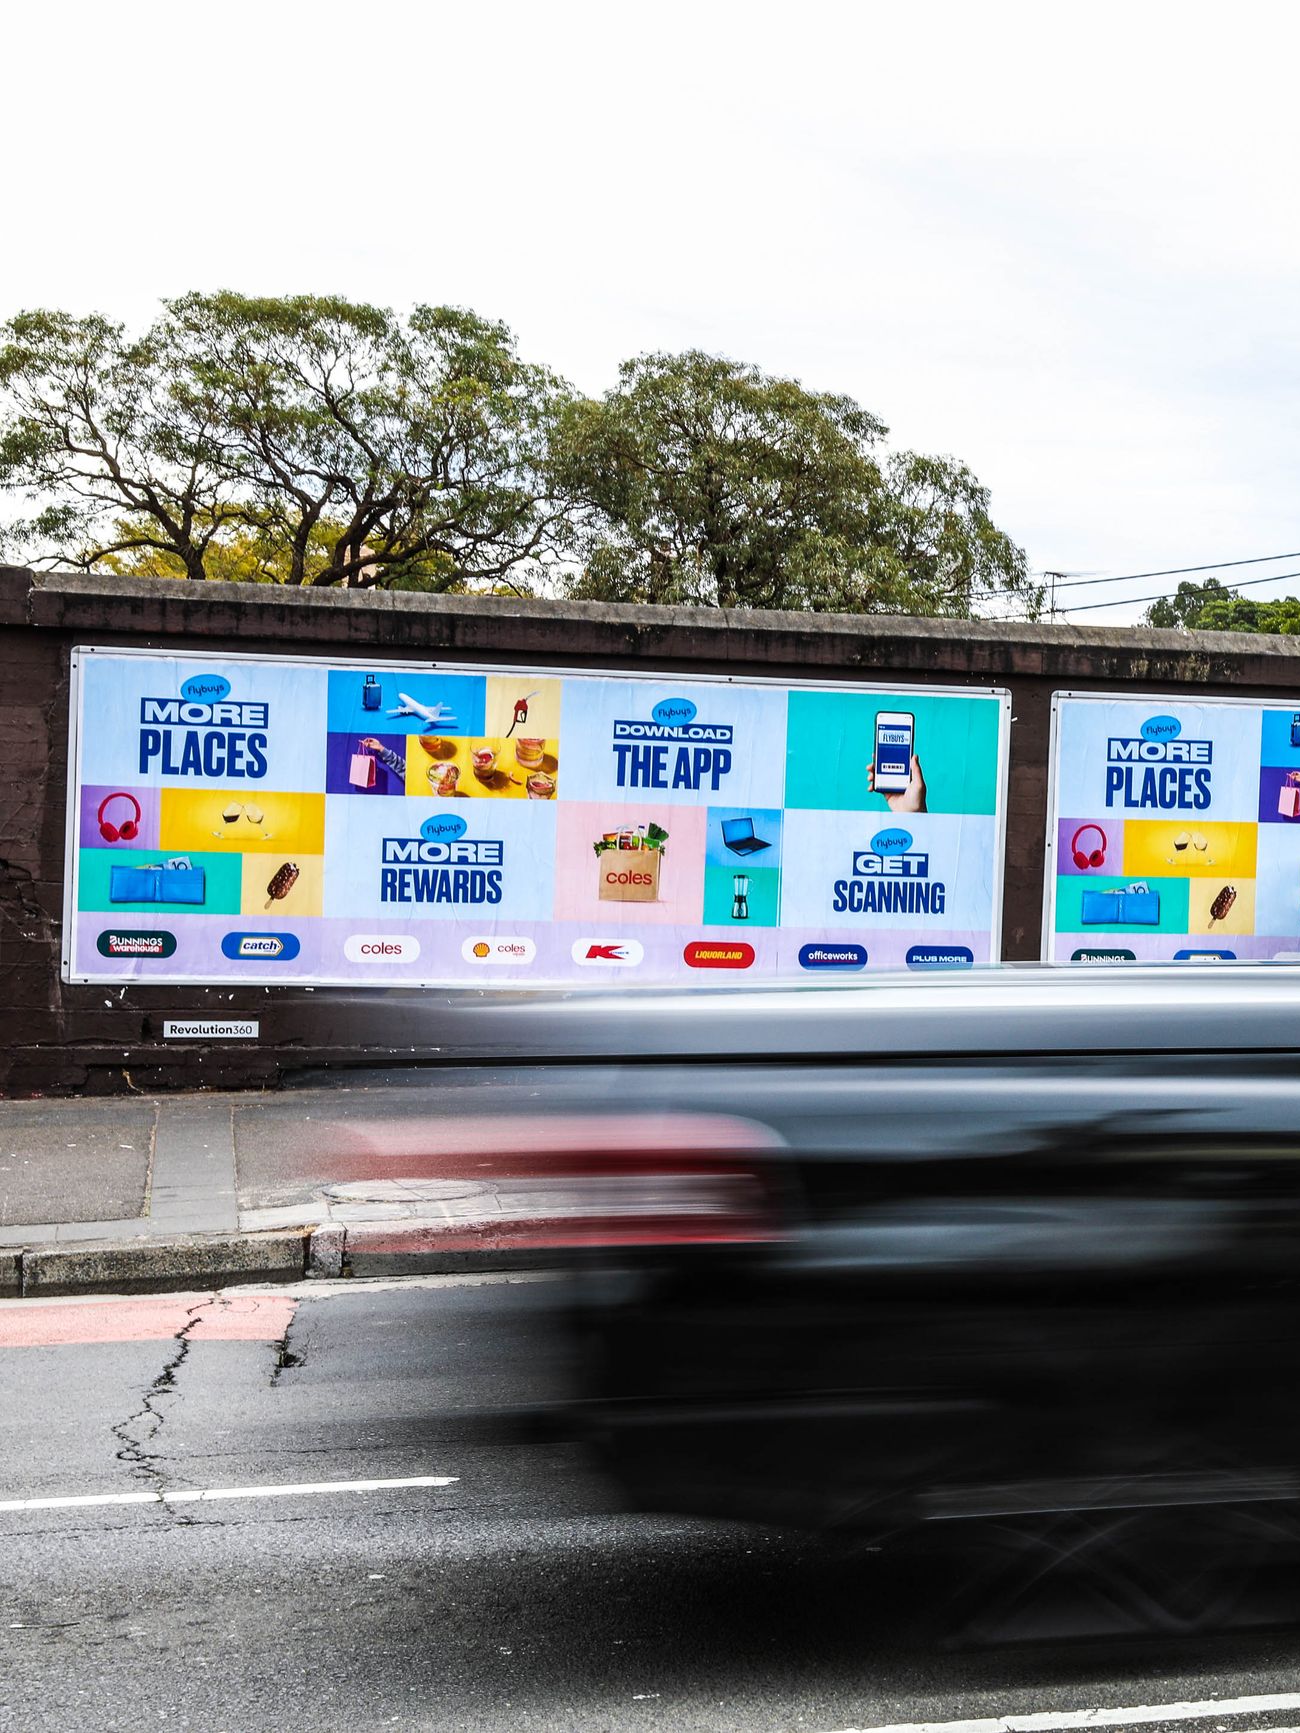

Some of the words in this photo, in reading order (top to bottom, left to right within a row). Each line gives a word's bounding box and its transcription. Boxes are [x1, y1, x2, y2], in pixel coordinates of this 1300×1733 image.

[187, 683, 225, 696] flybuys
[144, 702, 265, 726] MORE
[657, 705, 692, 720] flybuys
[615, 723, 731, 741] DOWNLOAD
[1145, 721, 1177, 736] flybuys
[139, 728, 268, 779] PLACES
[1109, 740, 1211, 762] MORE
[612, 744, 669, 788] THE
[672, 747, 732, 791] APP
[1105, 765, 1212, 810] PLACES
[426, 821, 462, 835] flybuys
[876, 834, 908, 849] flybuys
[385, 840, 501, 863] MORE
[855, 853, 925, 876] GET
[605, 869, 652, 887] coles
[381, 868, 503, 904] REWARDS
[833, 879, 945, 915] SCANNING
[109, 935, 162, 946] BUNNINGS
[243, 940, 278, 951] catch
[360, 941, 402, 955] coles
[497, 943, 526, 953] coles
[112, 945, 161, 953] warehouse
[695, 950, 743, 960] LIQUORLAND
[808, 951, 858, 961] officeworks
[912, 955, 937, 963] PLUS
[938, 955, 967, 963] MORE
[170, 1024, 253, 1036] Revolution360
